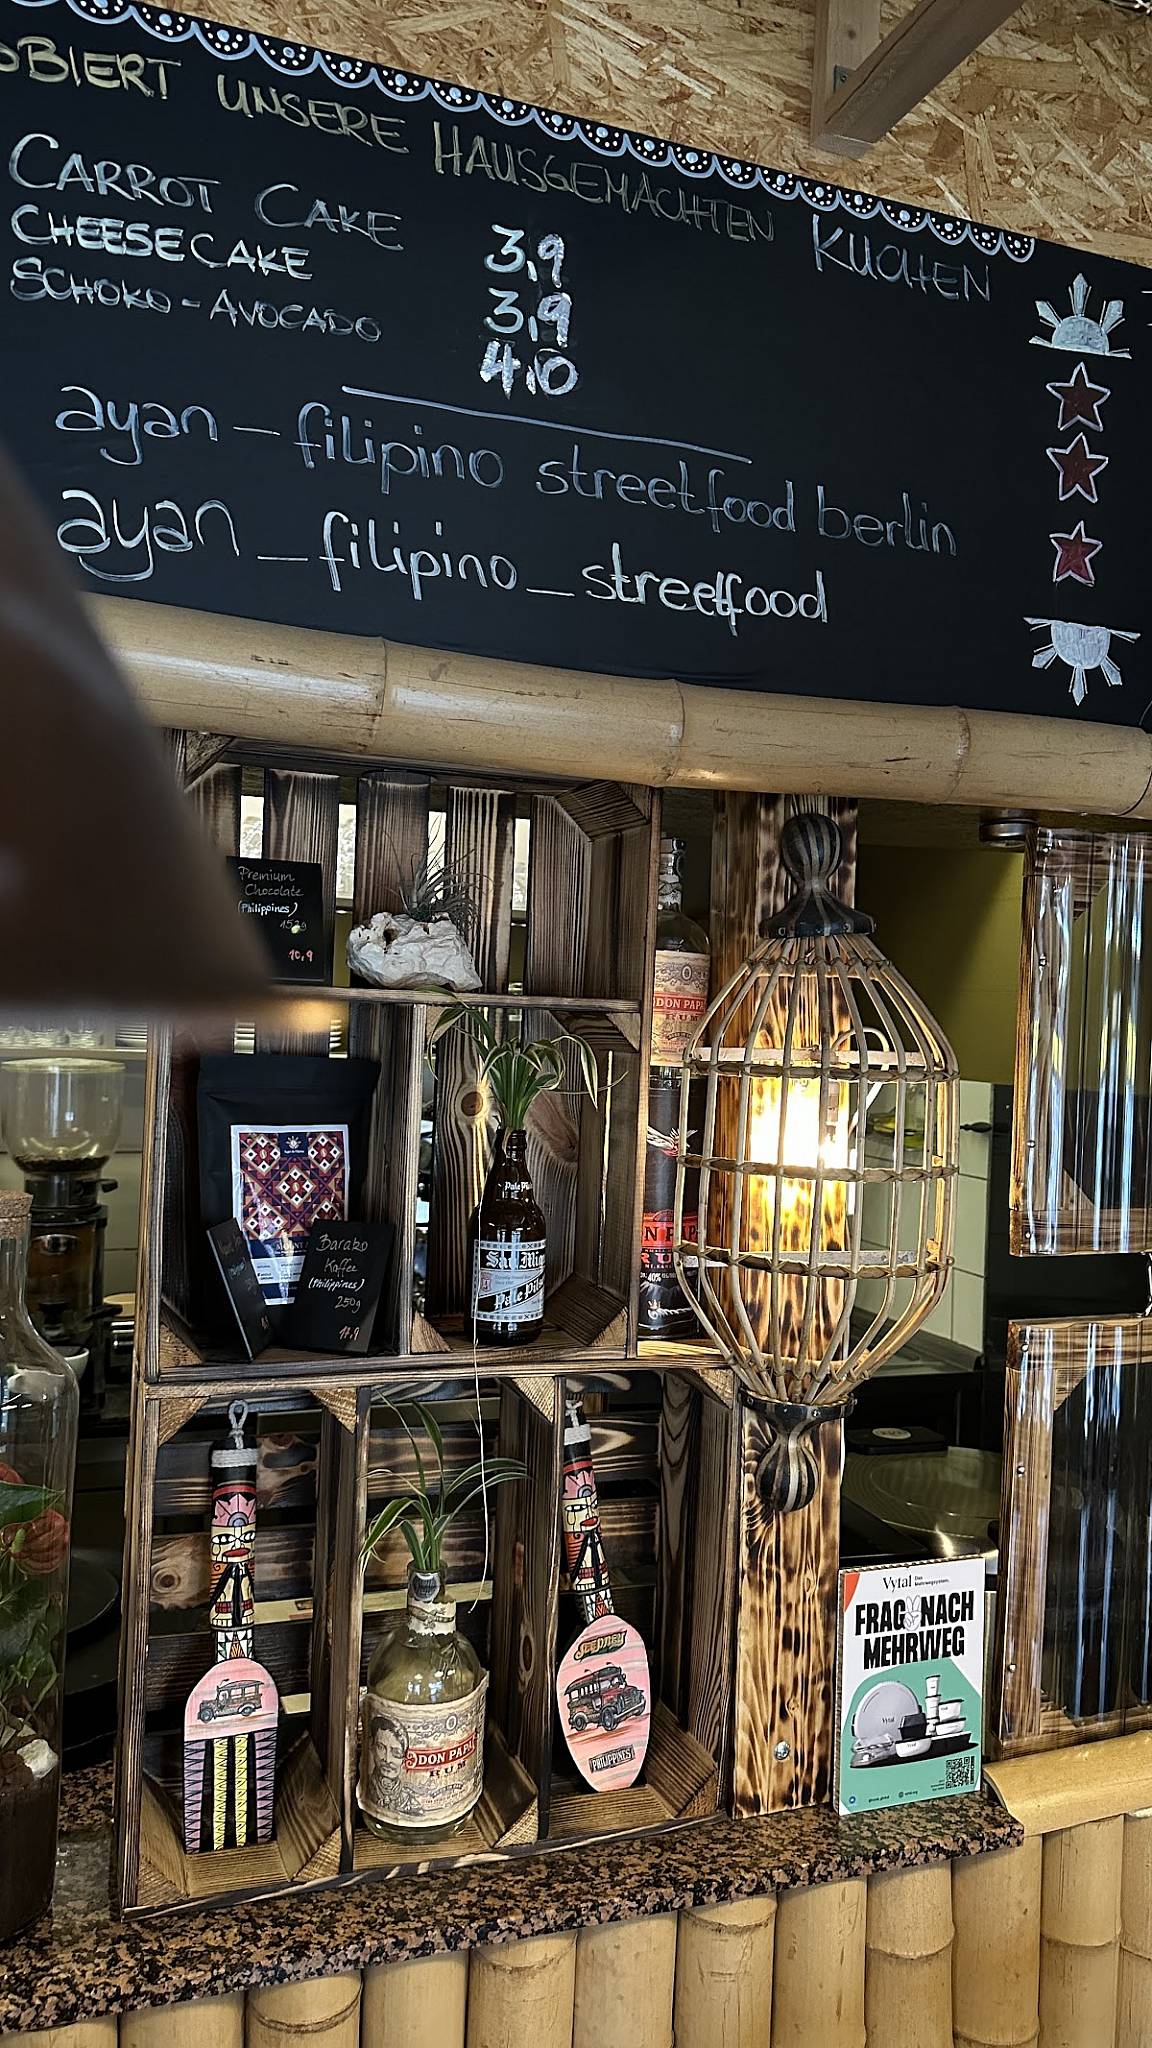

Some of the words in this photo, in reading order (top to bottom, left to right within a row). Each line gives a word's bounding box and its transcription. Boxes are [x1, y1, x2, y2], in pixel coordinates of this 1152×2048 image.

[217, 74, 409, 153] UNSERE
[432, 121, 774, 241] HAUSGEMACHTEN
[9, 133, 220, 213] CARROT
[256, 184, 404, 250] CAKE
[484, 224, 566, 288] 3,9
[484, 288, 572, 348] 3,9
[54, 385, 219, 465] ayan
[293, 401, 505, 495] filipino
[535, 443, 797, 535] streetfood
[816, 484, 958, 557] berlin
[238, 866, 295, 881] Premium
[244, 884, 304, 897] Chocolate
[655, 998, 681, 1009] DON
[334, 1295, 361, 1314] 250g
[882, 1574, 912, 1593] Vytal
[855, 1599, 906, 1637] FRAG
[920, 1590, 975, 1628] NACH
[863, 1626, 965, 1670] MEHRWEG
[418, 1752, 446, 1766] DON
